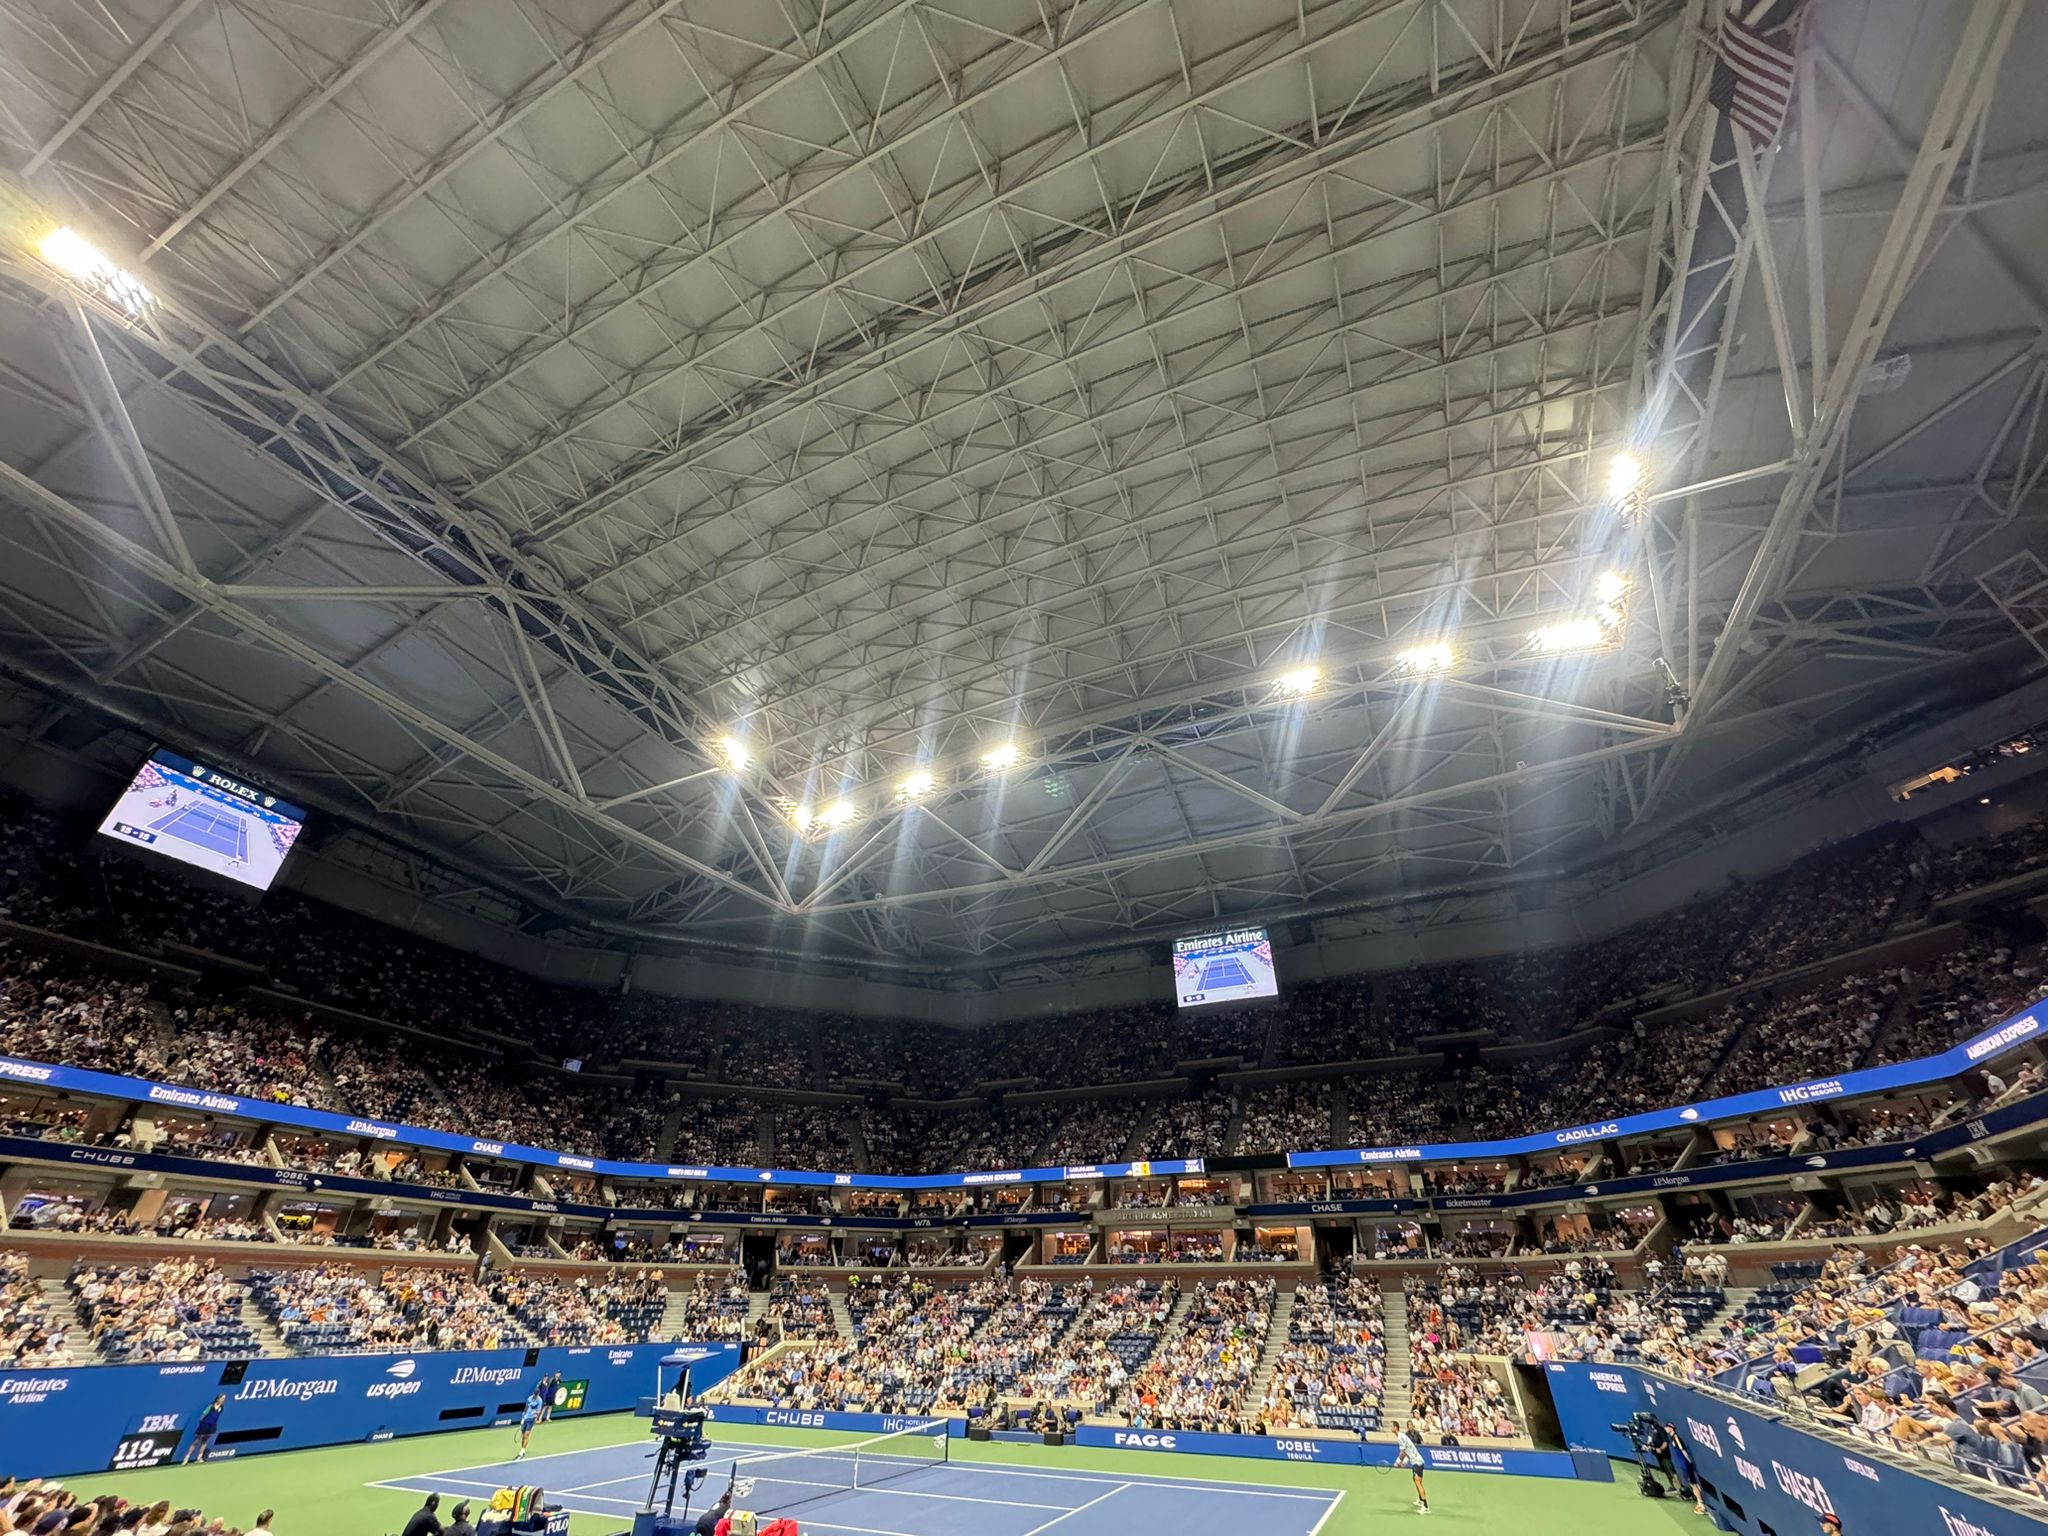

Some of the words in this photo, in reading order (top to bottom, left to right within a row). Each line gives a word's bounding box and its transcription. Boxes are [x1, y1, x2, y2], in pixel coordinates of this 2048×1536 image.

[208, 773, 259, 801] ROLEX
[1177, 937, 1224, 952] Emirates
[1225, 931, 1263, 946] Airline
[1967, 1034, 2003, 1060] AMERICAN
[2002, 1016, 2038, 1042] EXPRESS
[149, 1085, 200, 1105] Emirates
[201, 1095, 239, 1111] Airline
[1779, 1086, 1810, 1103] IHG
[1807, 1082, 1833, 1092] HOTELS
[1809, 1086, 1844, 1098] RESORTS
[346, 1120, 397, 1138] J.P.Morgan
[1556, 1123, 1619, 1143] CADILLAC
[473, 1141, 504, 1154] CHASE
[1360, 1150, 1394, 1161] Emirates
[1394, 1148, 1421, 1159] Airline
[70, 1149, 136, 1166] CHUBB
[275, 1170, 309, 1181] DOBEL
[963, 1173, 994, 1183] AMERICAN
[993, 1172, 1022, 1182] EXPRESS
[430, 1190, 445, 1199] IHG
[1311, 1203, 1343, 1213] CHASE
[1446, 1198, 1492, 1208] ticketmaster
[608, 1350, 634, 1360] Emirates
[450, 1366, 522, 1386] J.P.Morgan
[1589, 1371, 1624, 1383] AMERICAN
[0, 1378, 69, 1394] Emirates
[234, 1378, 339, 1401] J.P.Morgan
[1596, 1380, 1628, 1393] EXPRESS
[8, 1393, 47, 1404] Airline
[137, 1413, 179, 1433] IBM
[766, 1411, 825, 1426] CHUBB
[883, 1418, 905, 1431] IHG
[1114, 1432, 1177, 1449] FAGE
[1276, 1440, 1320, 1453] DOBEL
[113, 1438, 155, 1462] 119
[152, 1447, 174, 1457] MPH
[1286, 1452, 1313, 1460] TEQUILA
[1458, 1451, 1477, 1463] ONLY
[1476, 1452, 1492, 1463] ONE
[1771, 1459, 1825, 1515] CHASE
[546, 1518, 569, 1535] POLO
